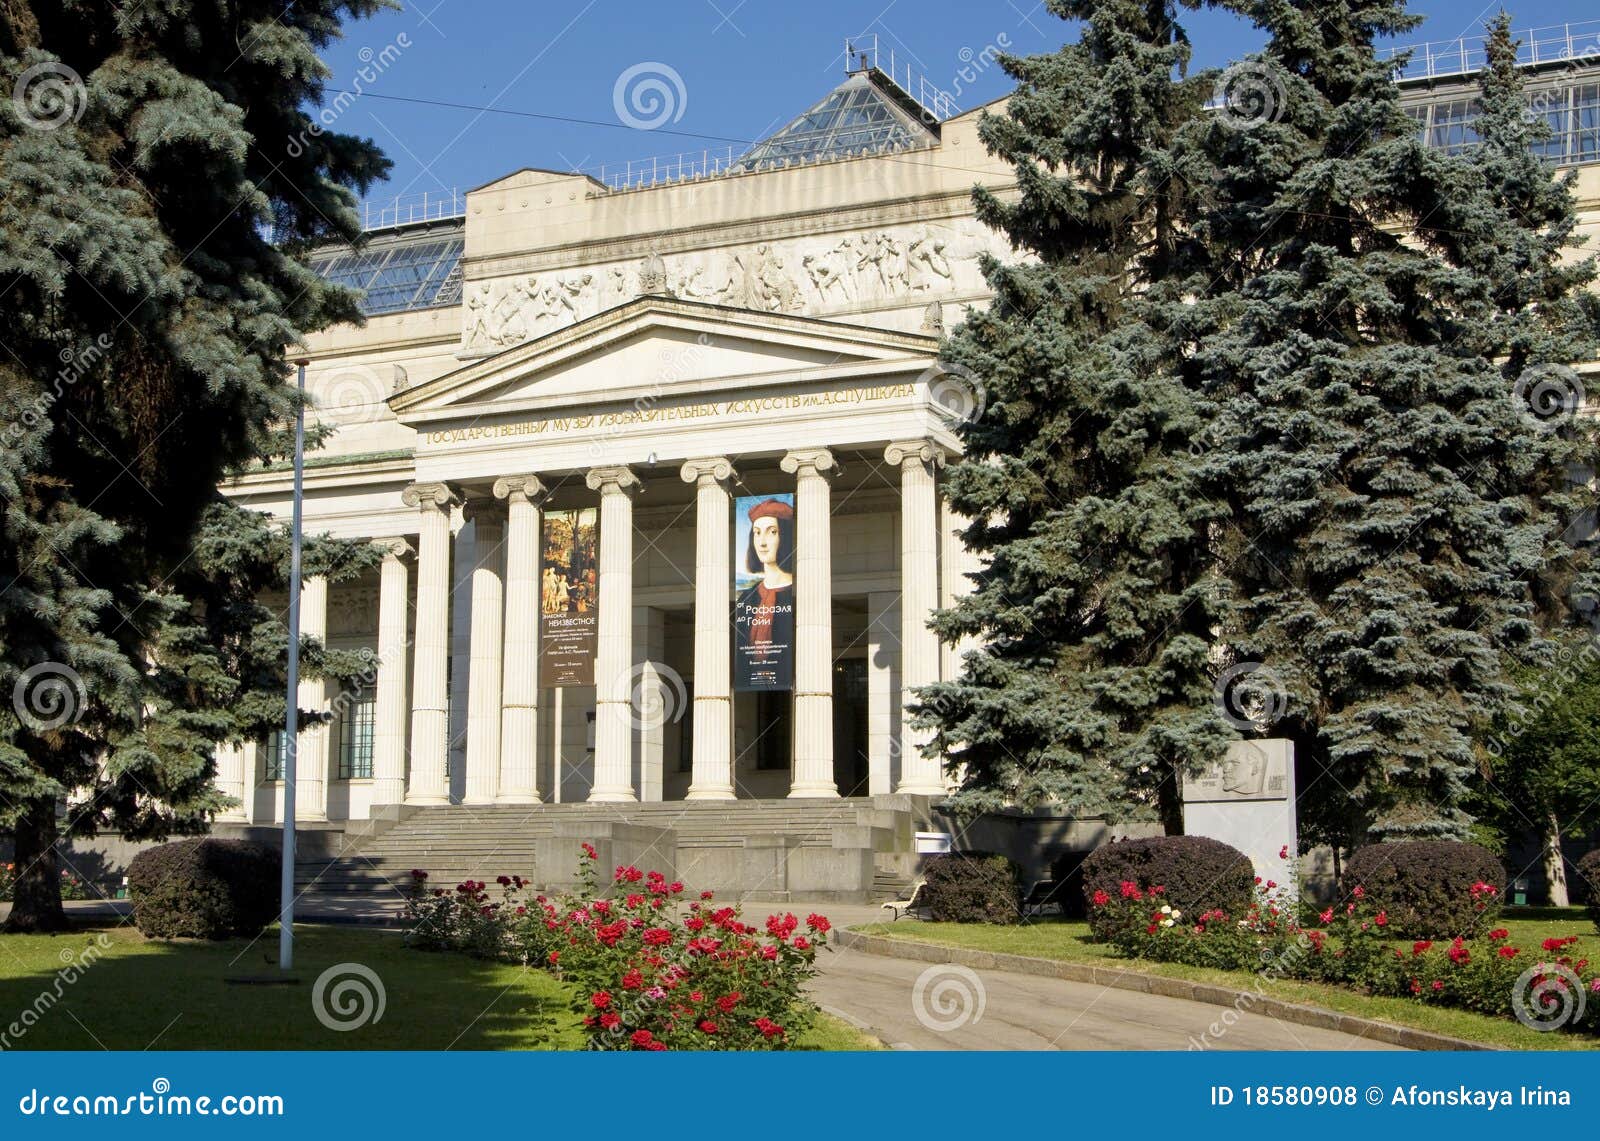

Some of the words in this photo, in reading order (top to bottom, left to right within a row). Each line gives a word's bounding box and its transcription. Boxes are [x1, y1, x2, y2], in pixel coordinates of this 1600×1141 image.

[426, 419, 549, 444] ГОСУДАРСТВЕННЫЙ
[552, 414, 594, 432] МУЗЕЙ
[599, 403, 719, 427] ИЗОБРАЗИТЕЛЬНЫХ
[726, 395, 800, 415] ИСКУССТВ
[745, 604, 792, 616] Рафаэля
[548, 617, 595, 627] НЕИЗВЕСТНОЕ
[747, 616, 771, 627] Гойи
